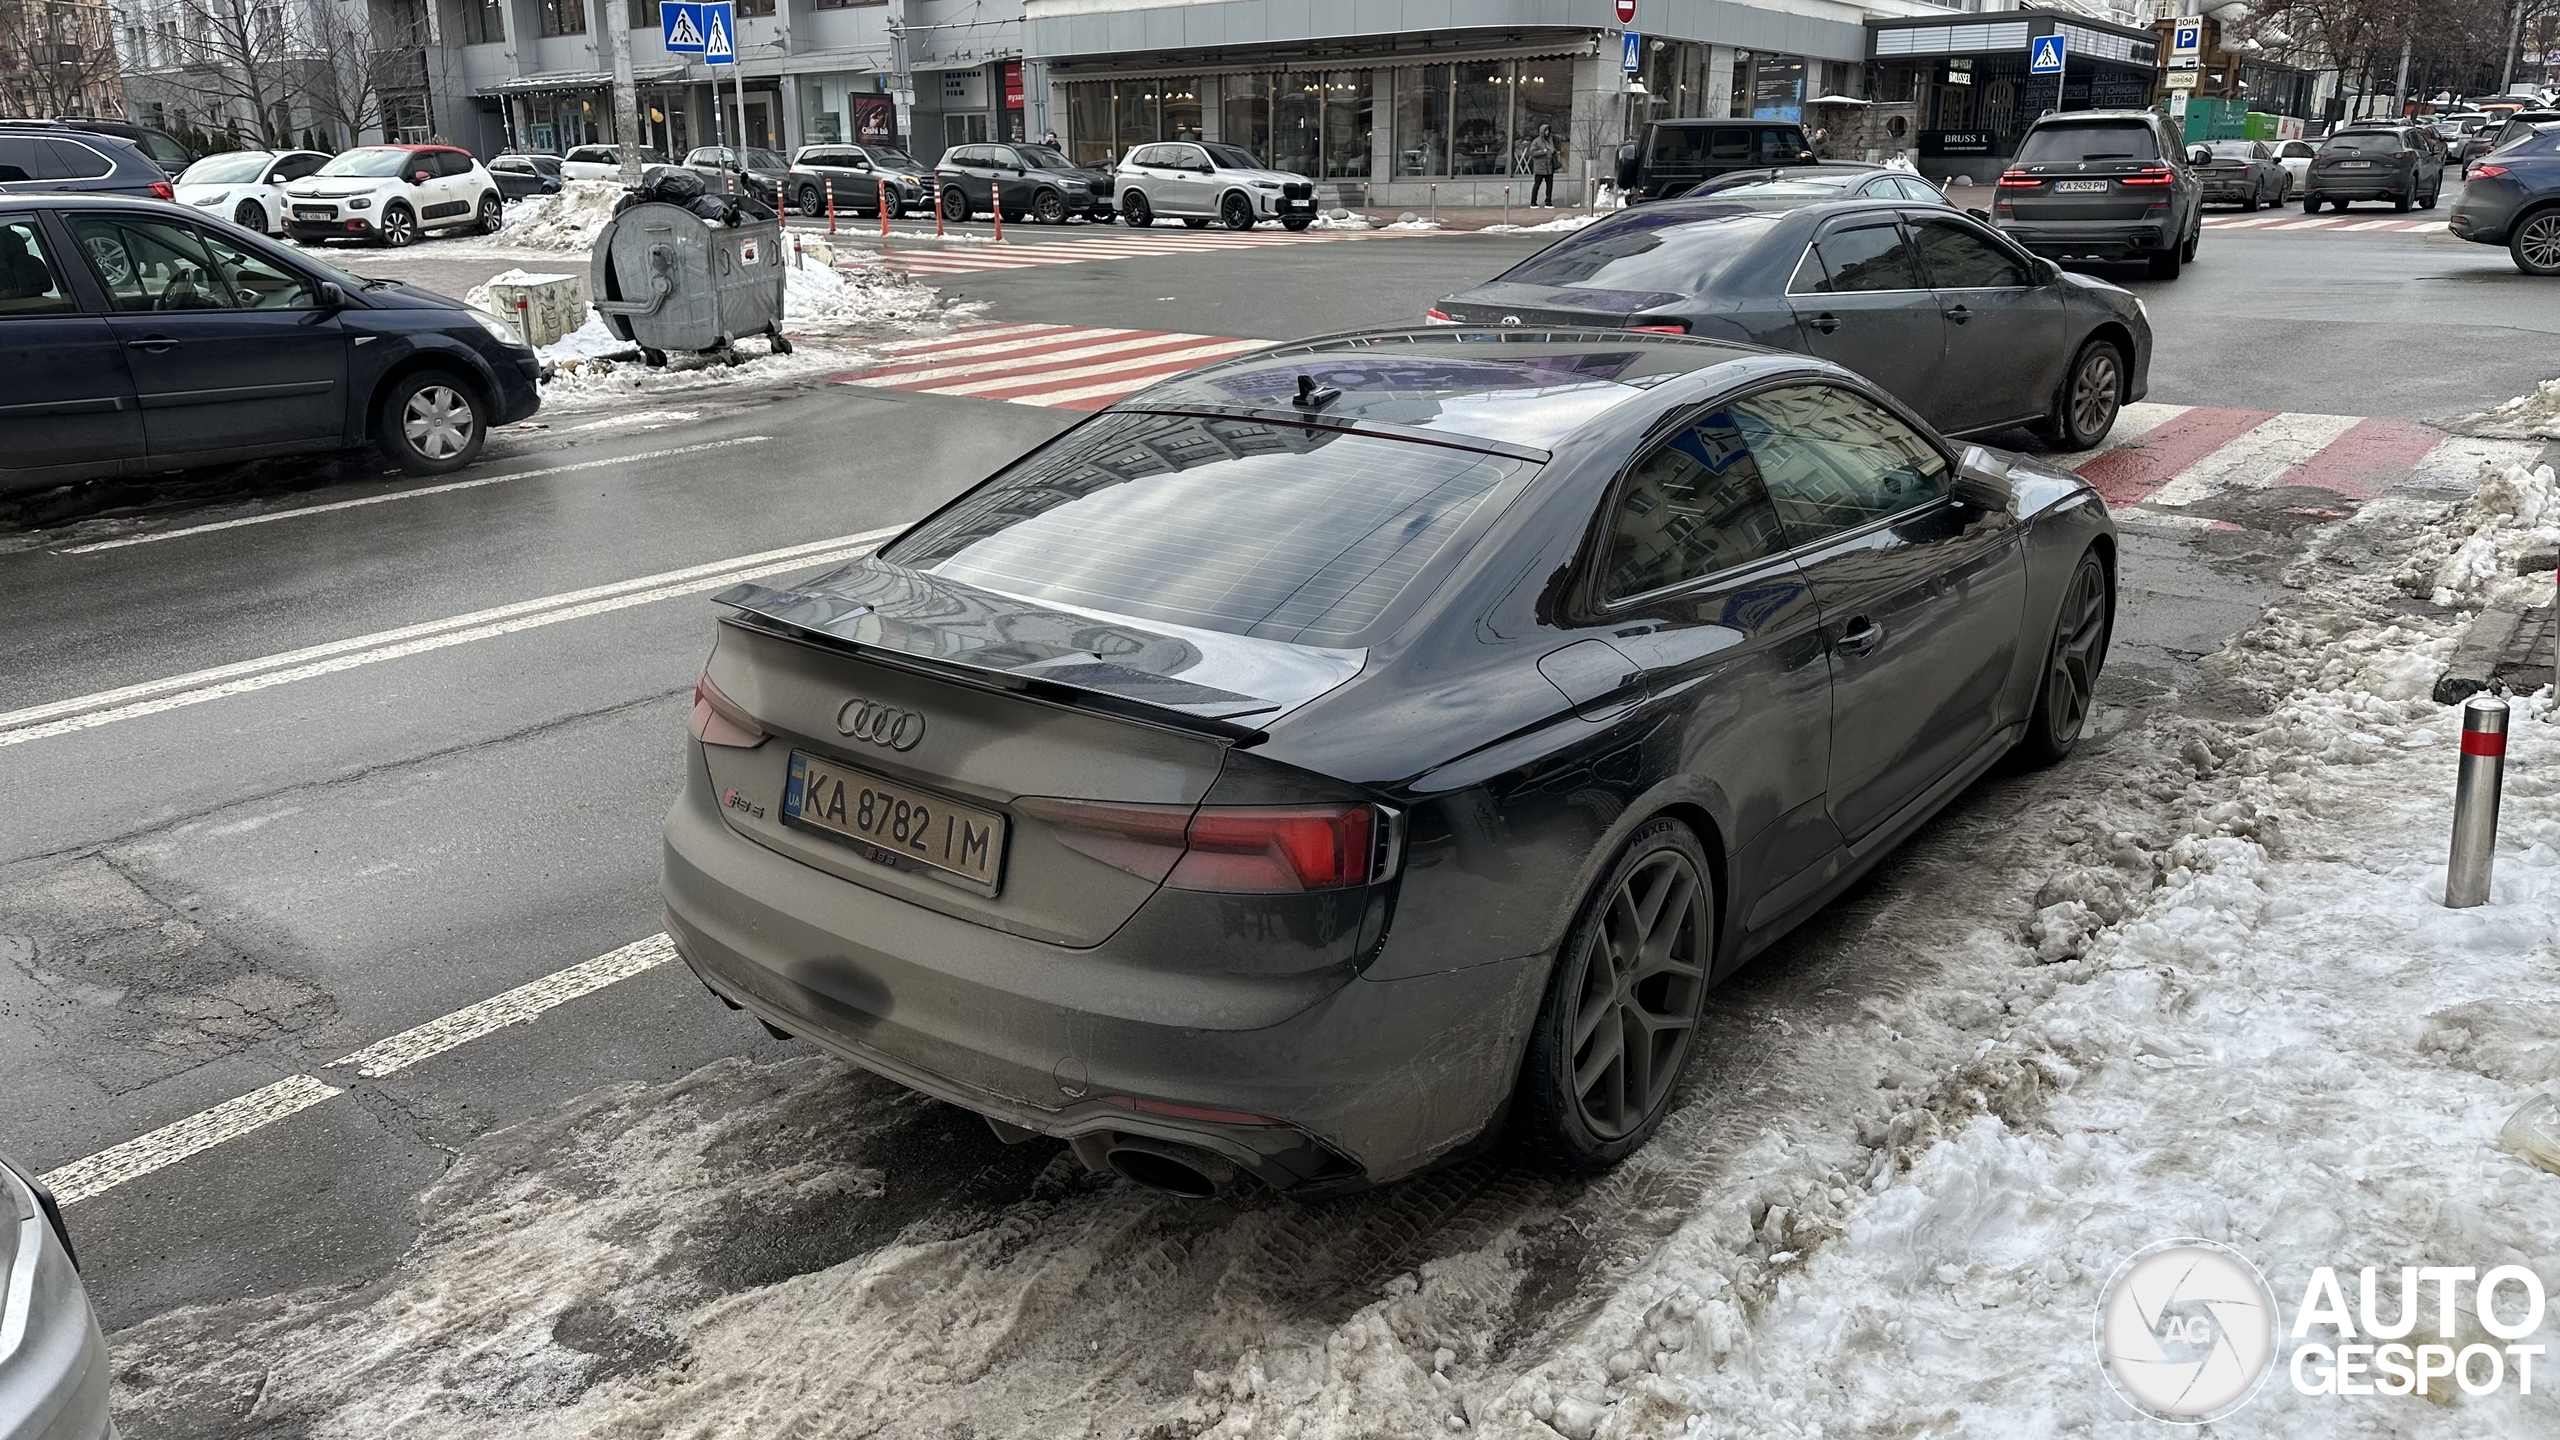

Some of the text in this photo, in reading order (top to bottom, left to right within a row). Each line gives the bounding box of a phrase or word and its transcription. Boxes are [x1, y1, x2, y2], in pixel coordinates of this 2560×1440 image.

[2178, 18, 2200, 27] ЗОНА
[2181, 30, 2194, 47] P
[945, 71, 981, 79] MENTORS
[1948, 71, 1971, 85] BRUSSEL
[2107, 85, 2141, 95] ORIGIN
[2105, 96, 2140, 104] STAGE
[2059, 181, 2106, 190] KA 2452 PH
[788, 792, 800, 807] UA
[804, 770, 991, 872] KA 8782 IM
[1632, 821, 1674, 847] NEXEN
